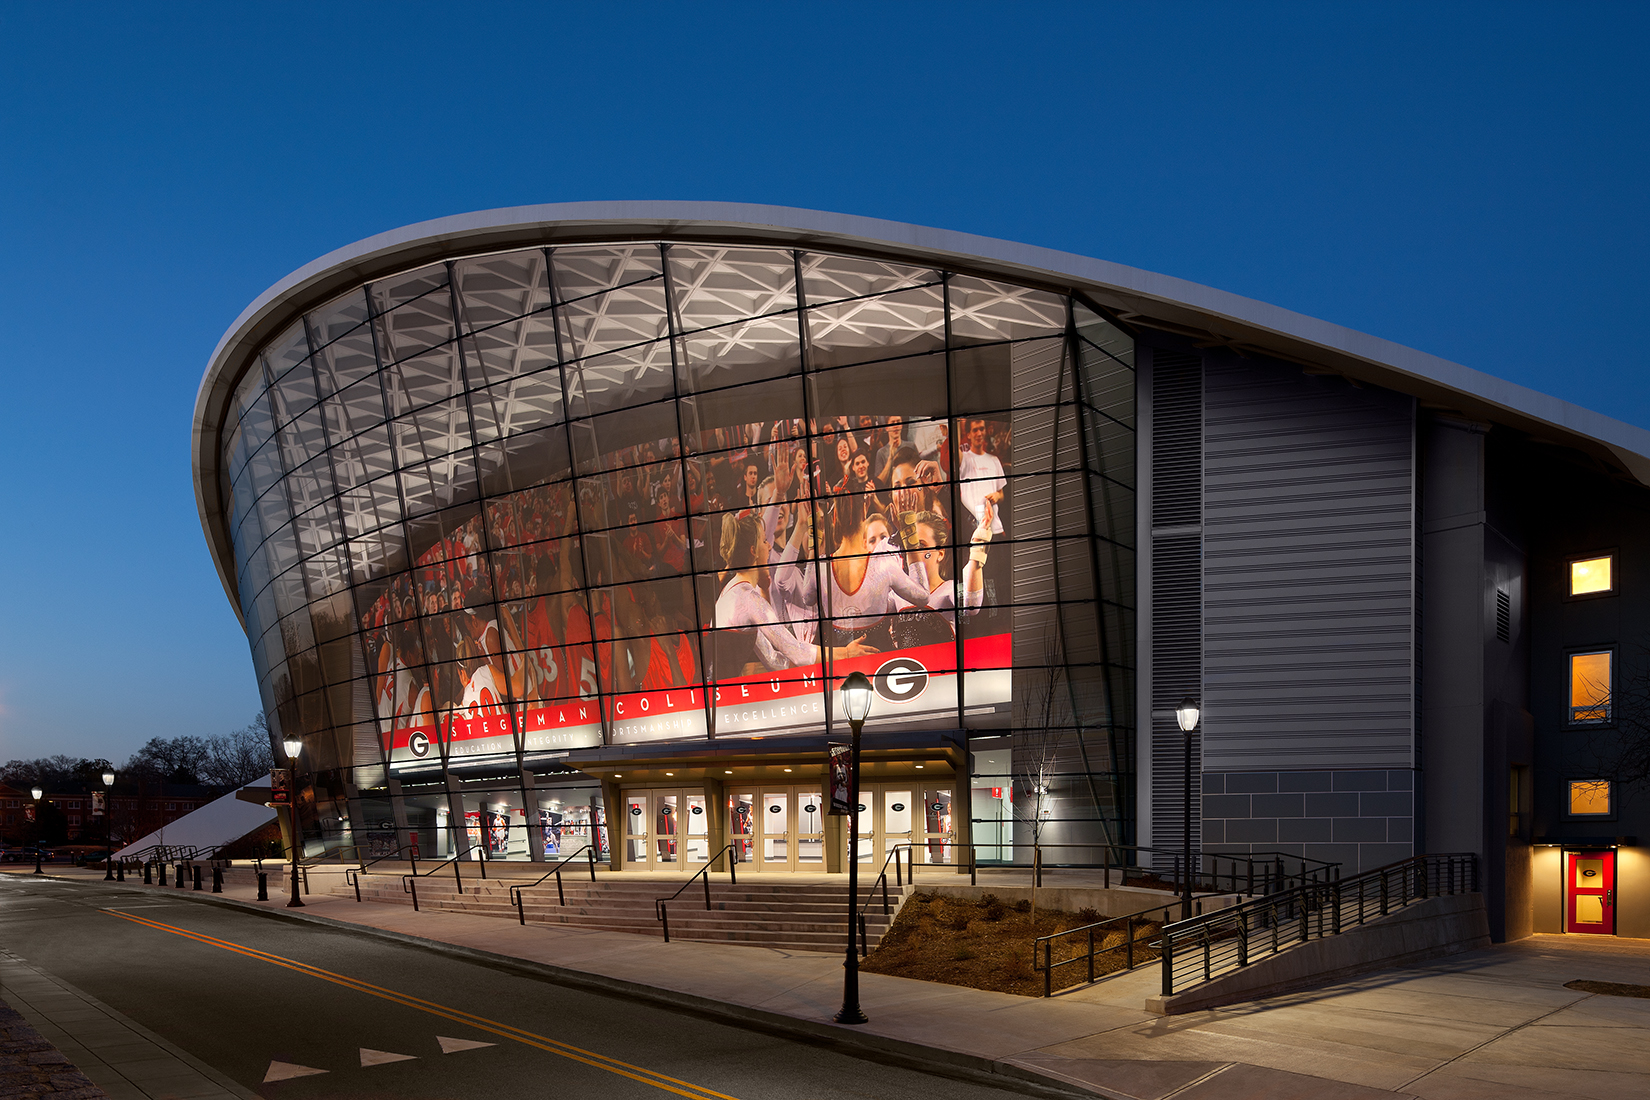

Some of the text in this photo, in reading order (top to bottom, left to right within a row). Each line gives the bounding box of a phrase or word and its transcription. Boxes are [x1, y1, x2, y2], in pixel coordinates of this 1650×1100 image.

[579, 656, 599, 701] 5
[874, 658, 928, 702] G
[451, 671, 816, 737] STEGEMAN COLISEUM
[724, 702, 819, 723] EXCELLENCE
[527, 733, 574, 746] NTEGRITY
[597, 718, 692, 738] SORTSMANSHIP
[408, 731, 430, 758] G
[454, 742, 502, 755] EDUCATION
